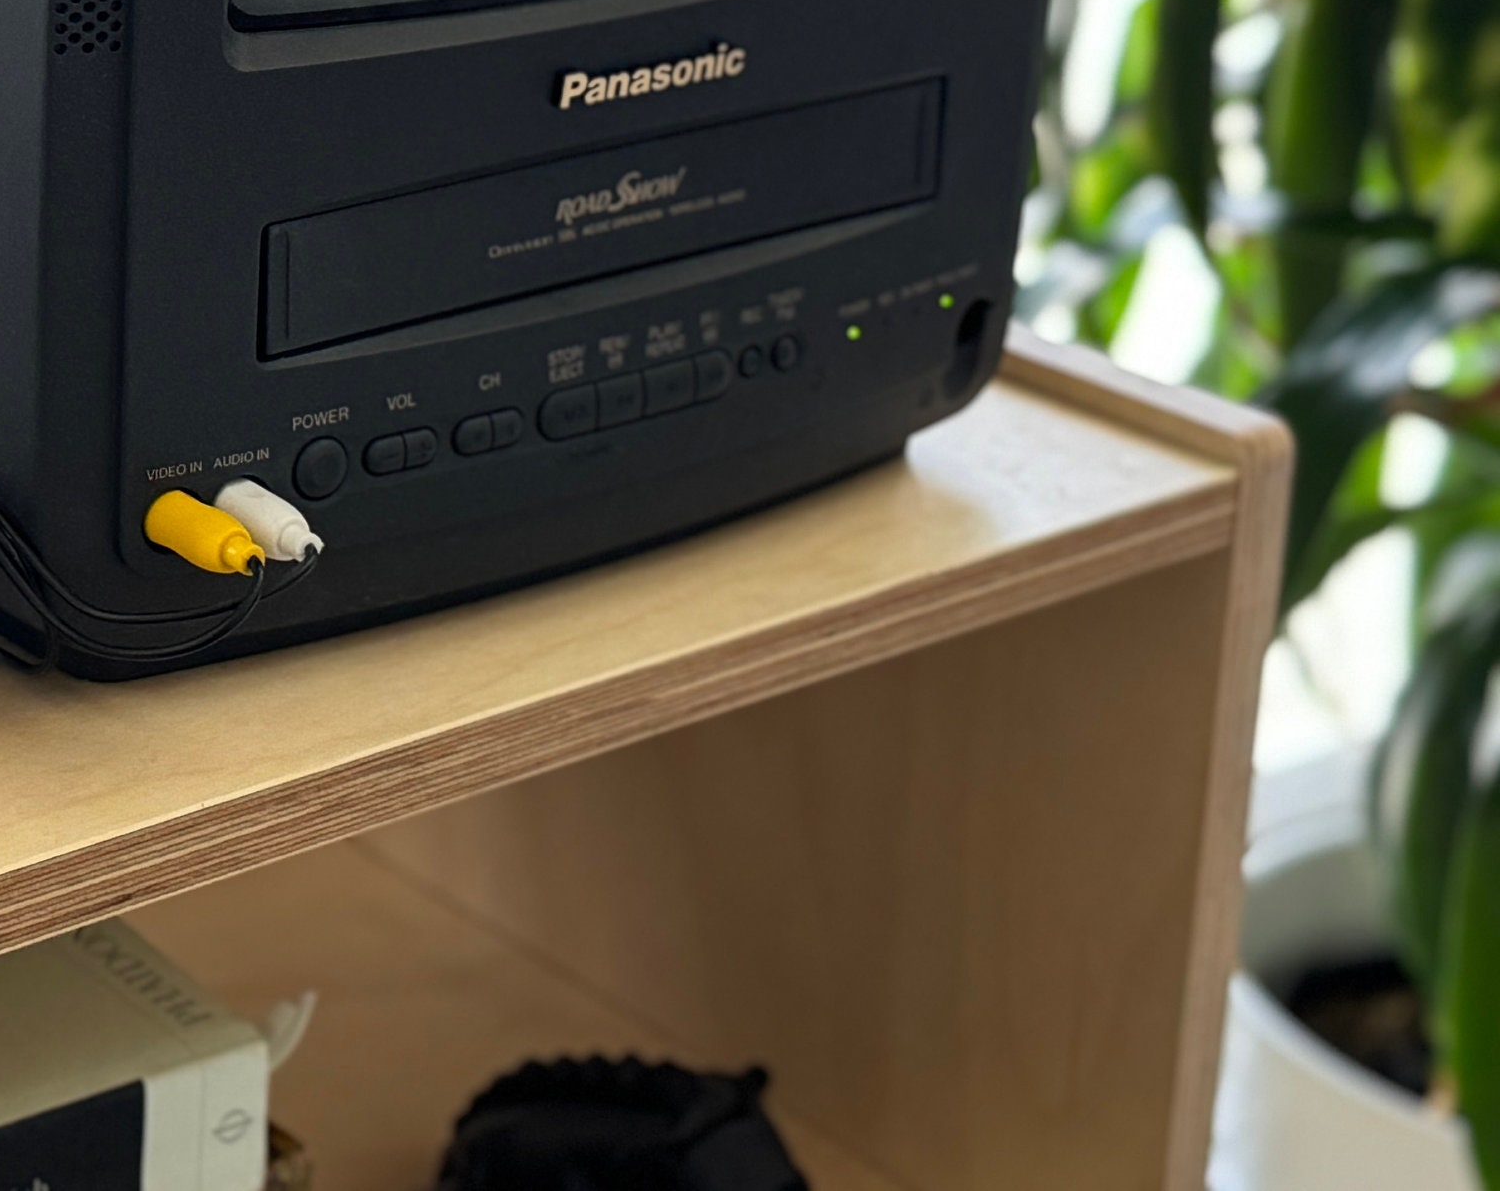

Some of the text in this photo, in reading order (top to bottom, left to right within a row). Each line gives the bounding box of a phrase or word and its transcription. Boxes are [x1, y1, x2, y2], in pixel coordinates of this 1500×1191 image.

[557, 41, 748, 111] Panasonic
[478, 372, 503, 391] CH
[386, 392, 418, 411] VOL
[291, 406, 350, 432] POWER
[212, 447, 270, 469] AUDIO IN
[145, 460, 203, 482] VIDEO IN
